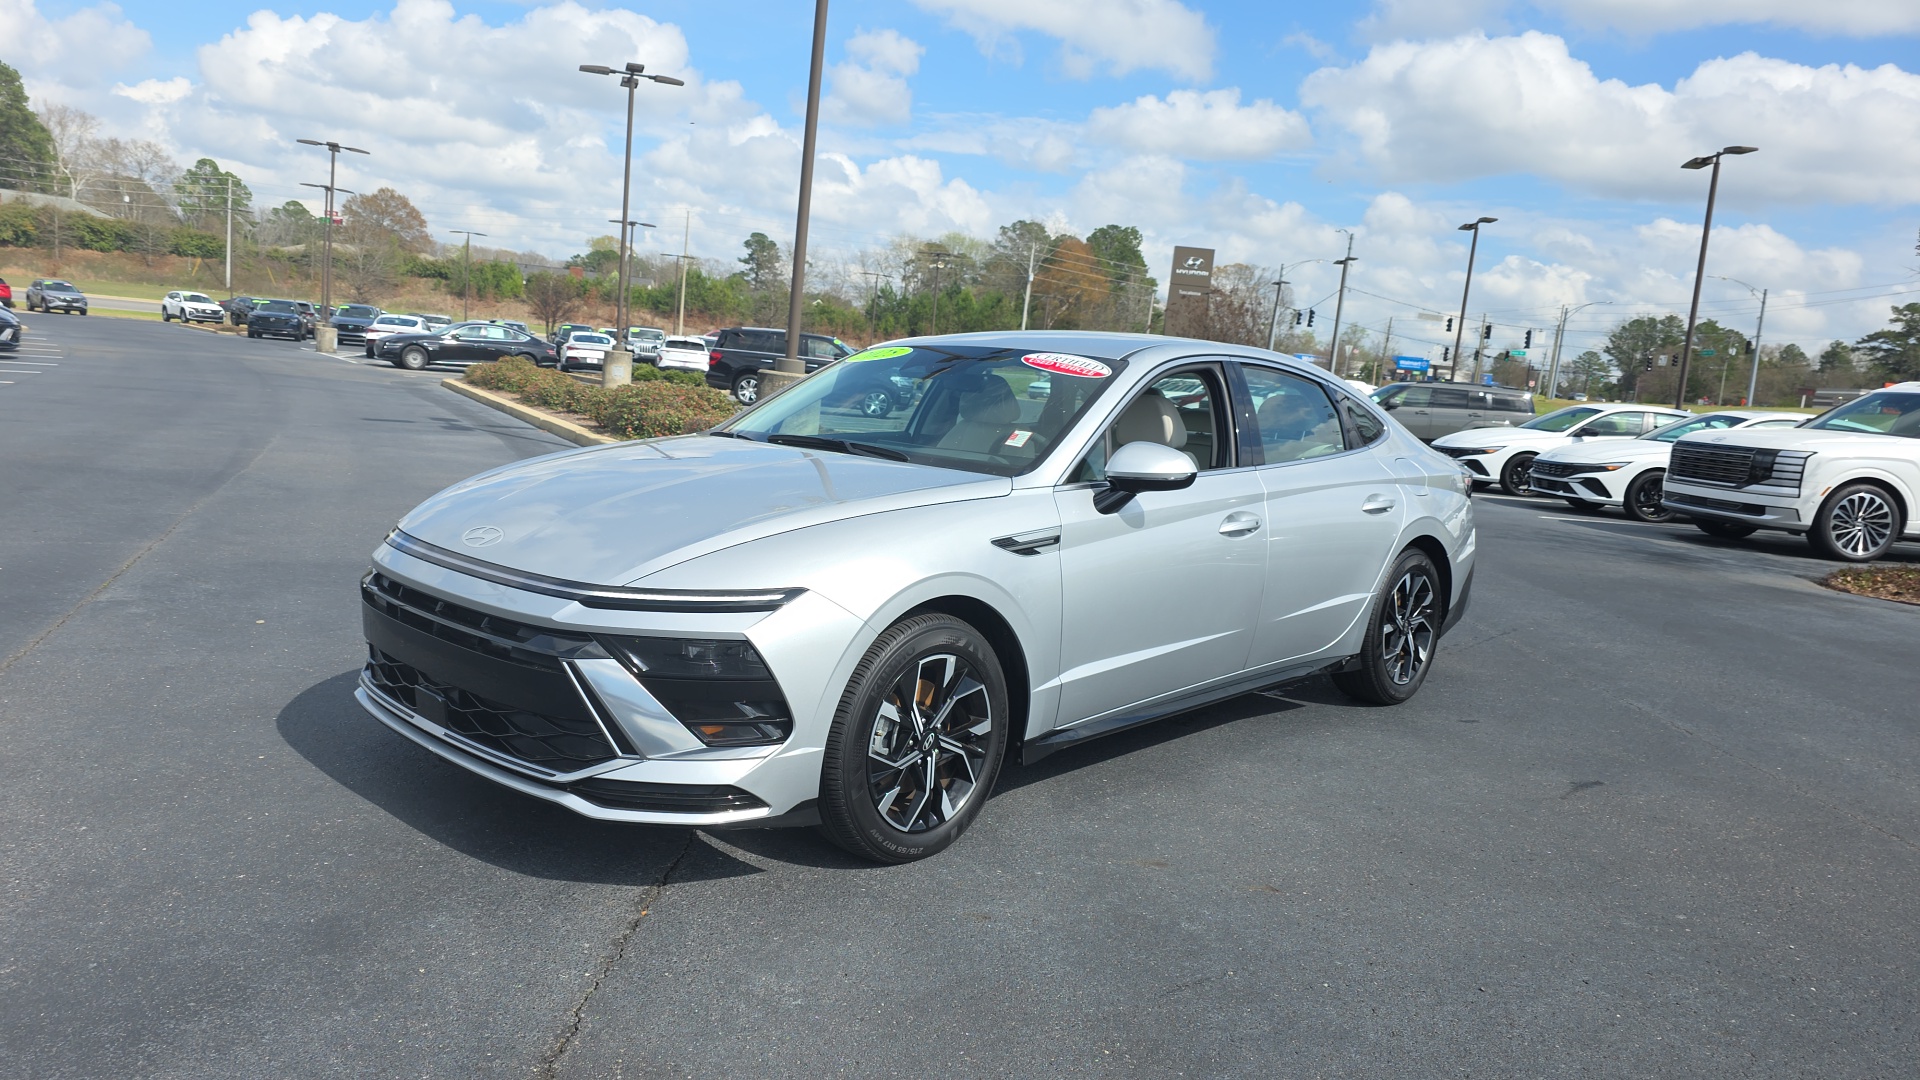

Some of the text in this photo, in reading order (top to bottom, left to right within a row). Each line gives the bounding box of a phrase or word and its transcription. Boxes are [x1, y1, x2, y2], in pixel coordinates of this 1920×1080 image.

[1028, 358, 1097, 376] USED VEHICLE
[1036, 353, 1105, 371] CERTIFIED
[882, 841, 897, 851] R17
[896, 846, 924, 855] 215/55
